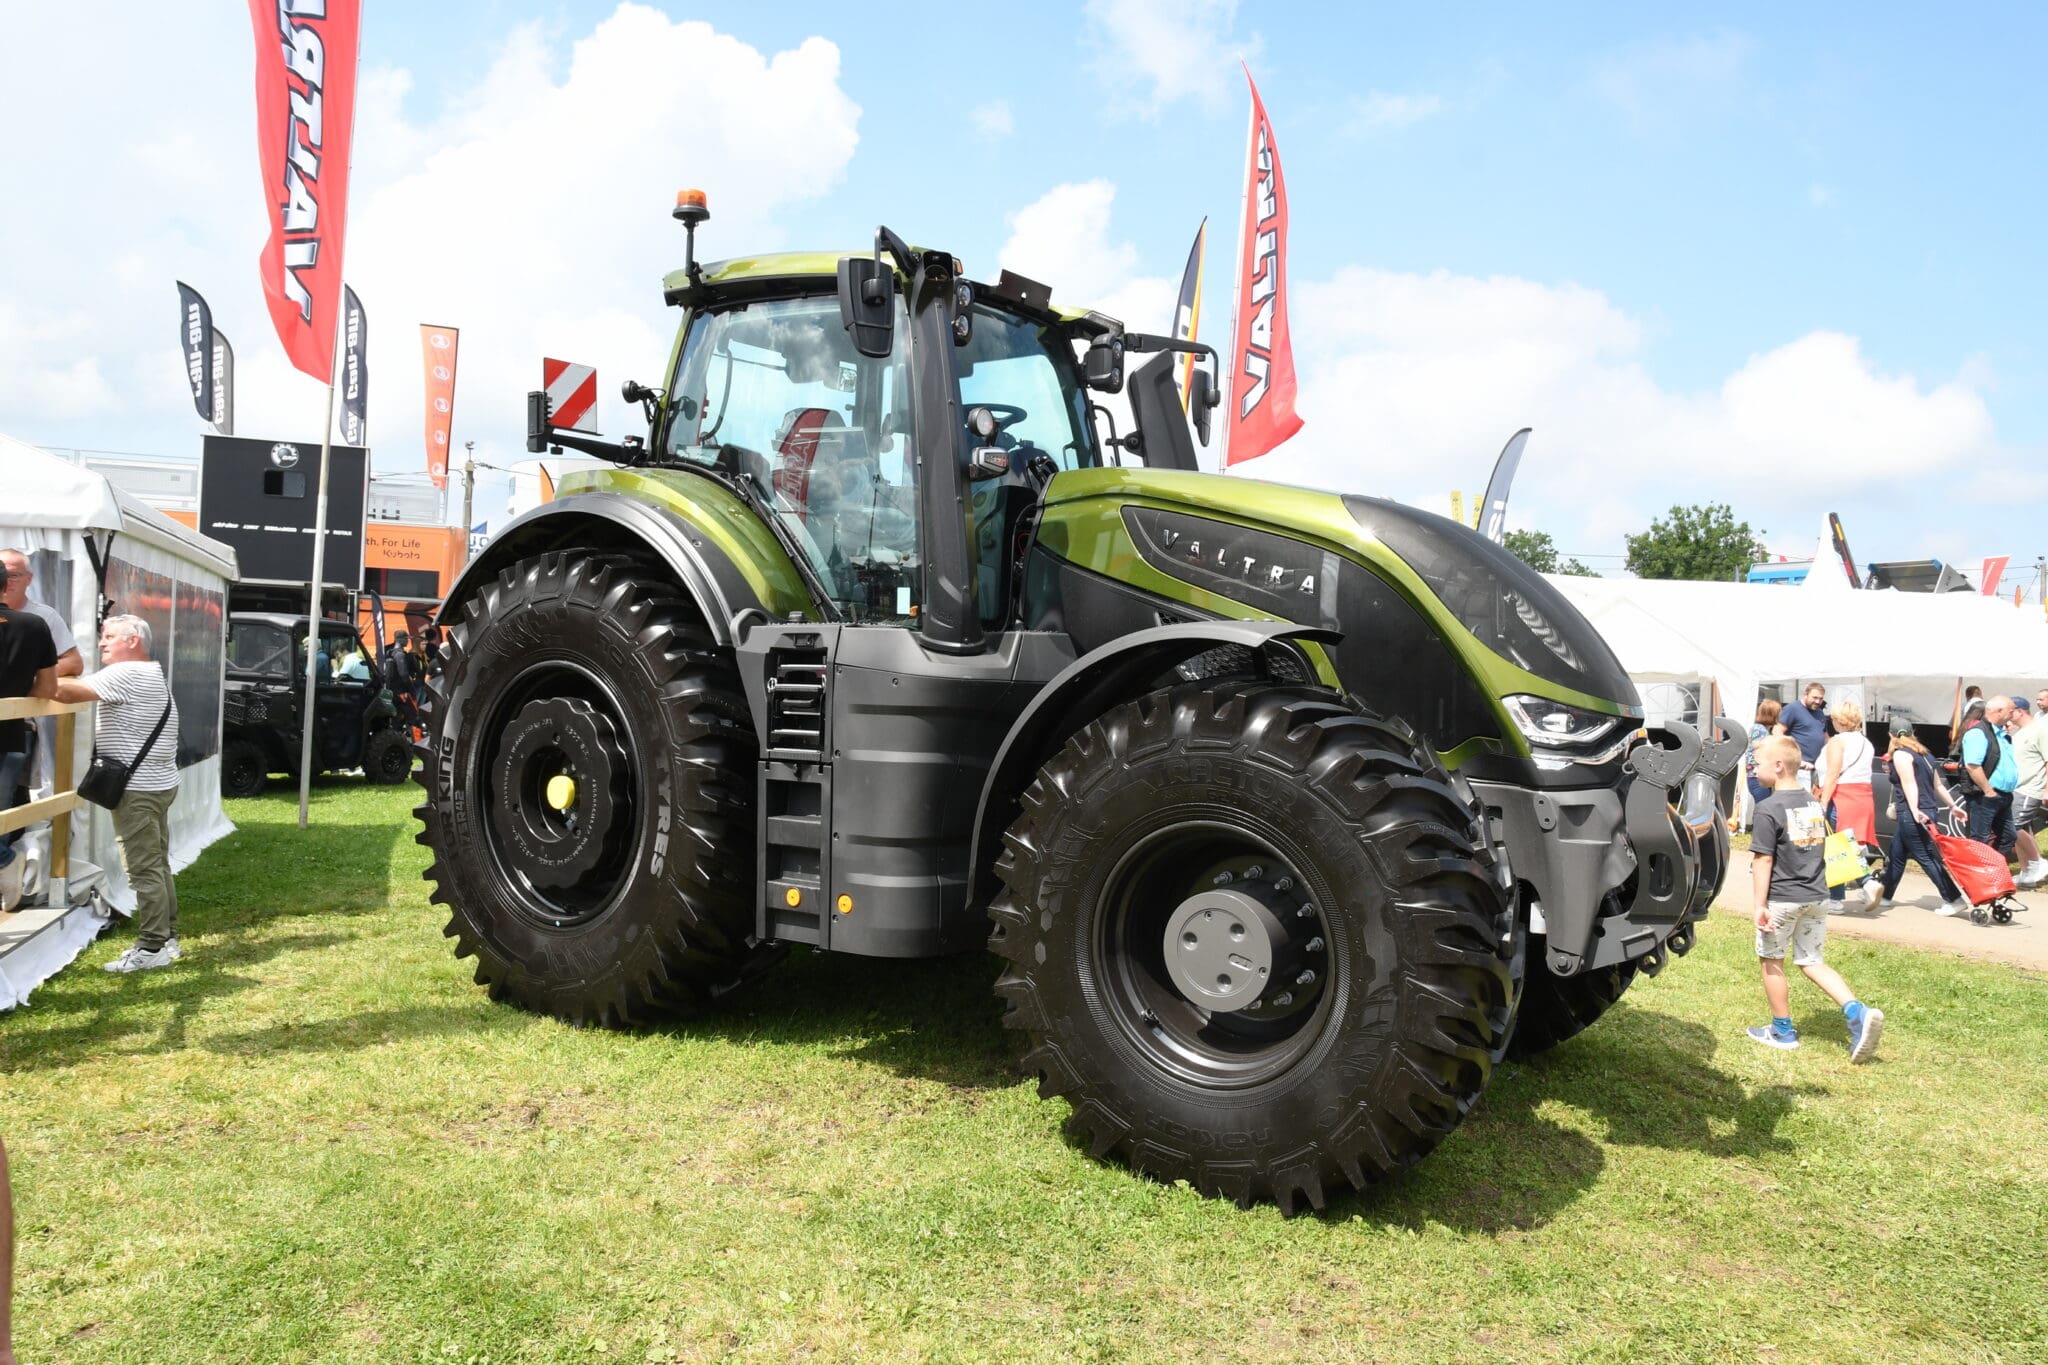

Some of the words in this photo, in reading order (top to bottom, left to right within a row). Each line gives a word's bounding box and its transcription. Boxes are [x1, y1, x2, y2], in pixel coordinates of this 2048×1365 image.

[1241, 115, 1279, 423] VALTRA
[382, 537, 398, 548] For
[402, 537, 421, 549] Life
[1163, 529, 1315, 594] VALTRA
[650, 755, 672, 879] TYRES
